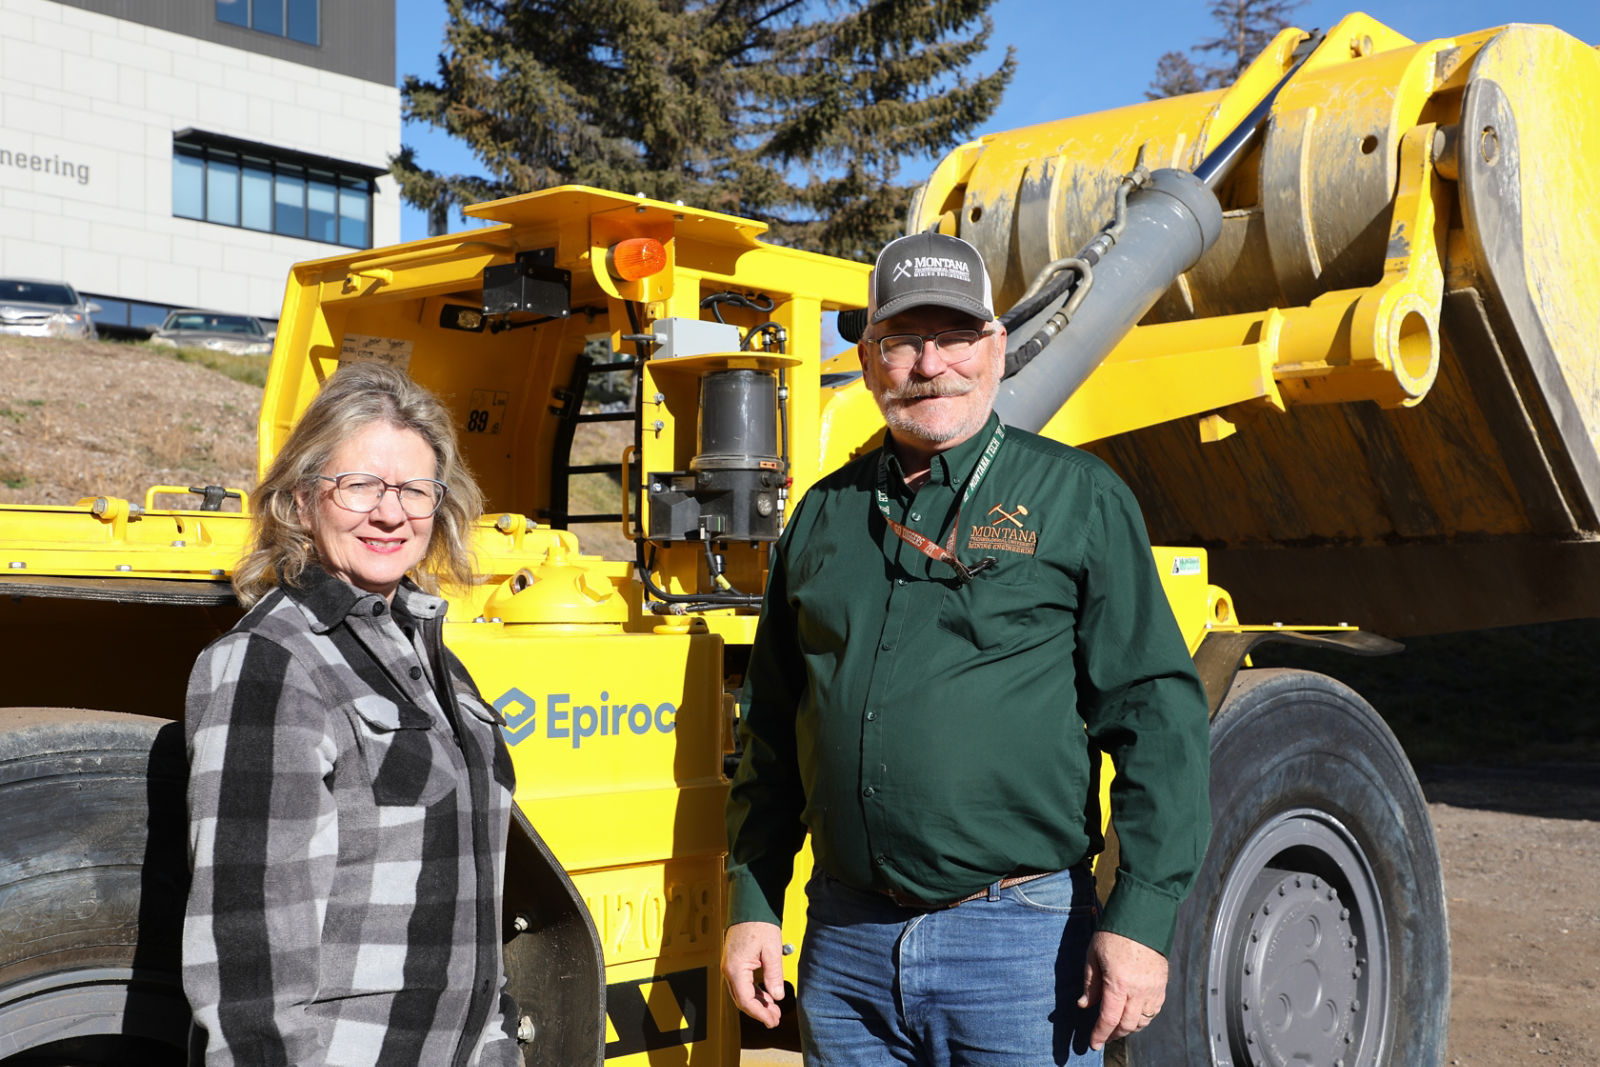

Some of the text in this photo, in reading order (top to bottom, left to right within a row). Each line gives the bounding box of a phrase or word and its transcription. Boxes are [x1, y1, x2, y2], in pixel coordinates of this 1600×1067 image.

[0, 148, 90, 185] neering
[914, 256, 970, 272] MONTANA
[467, 409, 489, 433] 89
[969, 436, 1001, 491] MONTANA TECH
[971, 525, 1037, 543] MONTANA
[547, 691, 677, 749] Epiroc
